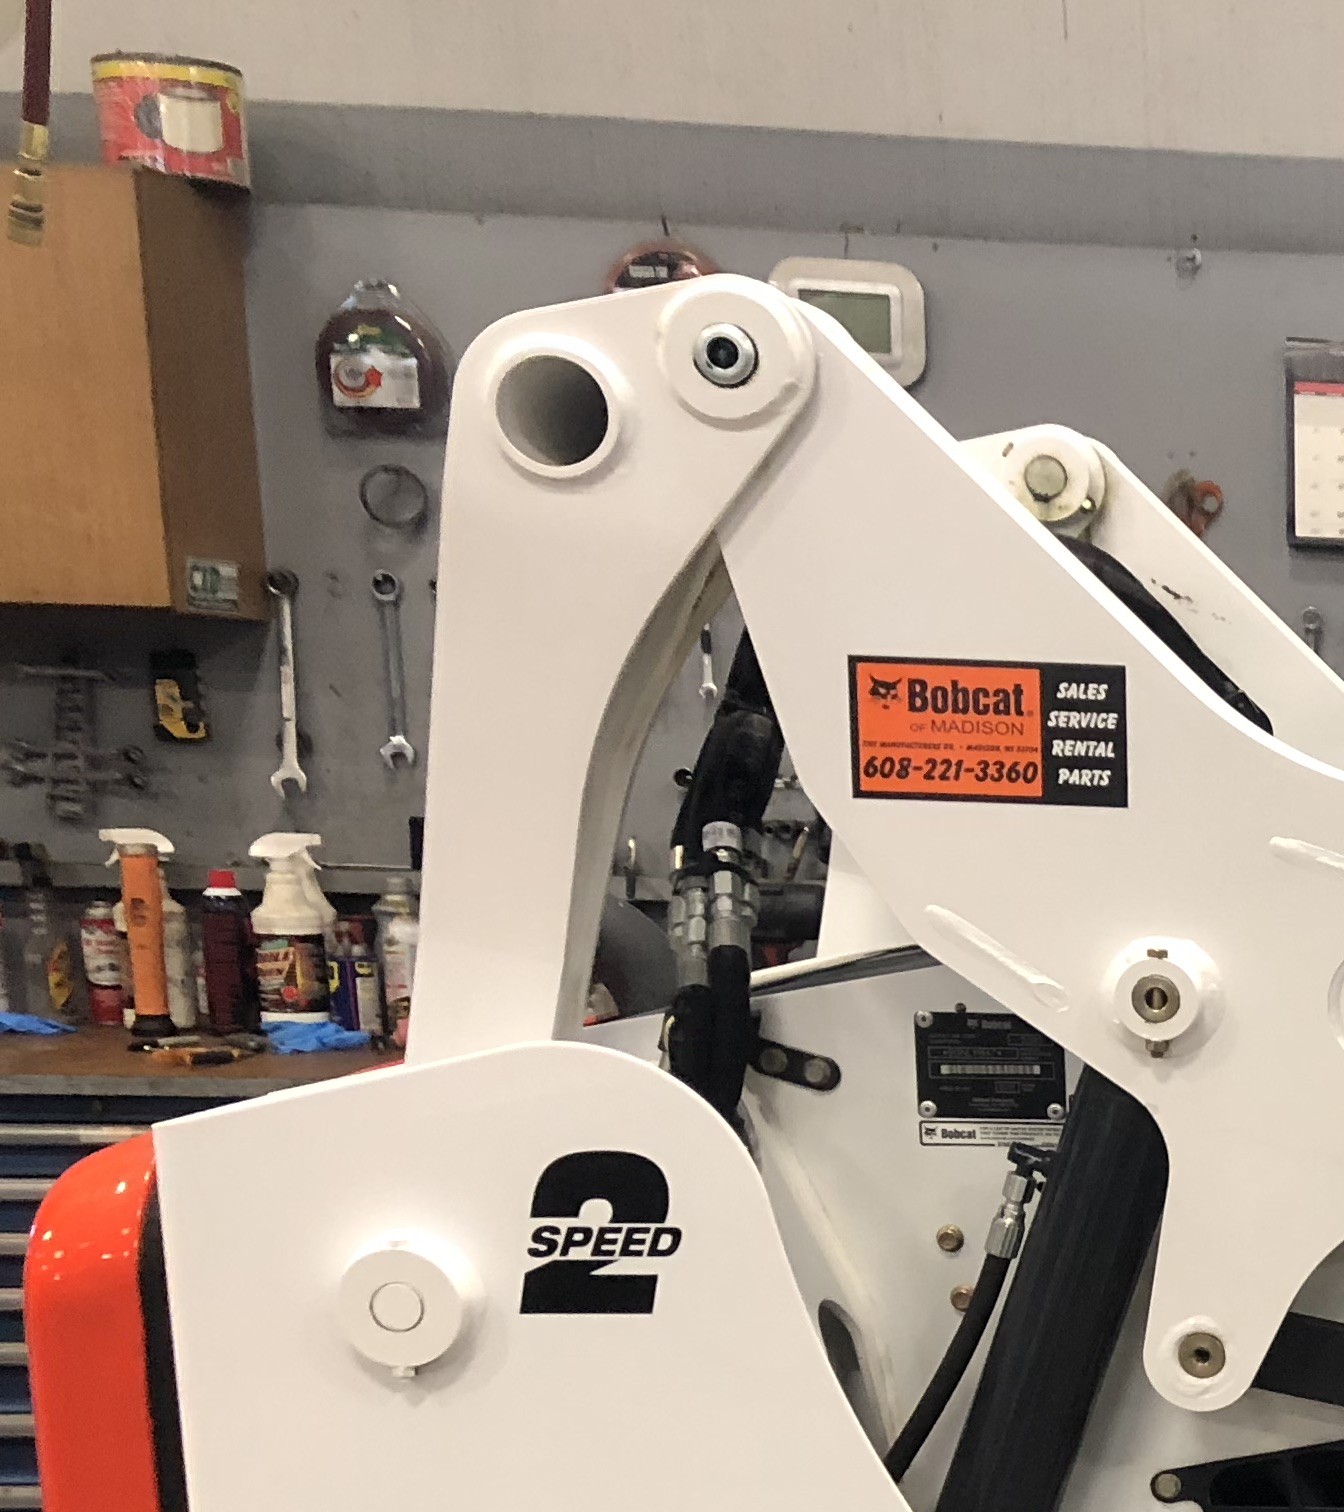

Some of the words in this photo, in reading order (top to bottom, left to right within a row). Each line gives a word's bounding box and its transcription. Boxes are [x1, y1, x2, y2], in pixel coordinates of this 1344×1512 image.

[907, 678, 1024, 717] Bobcat
[1056, 682, 1108, 700] SALES
[910, 723, 925, 732] OF
[930, 719, 1024, 737] MADISON
[1047, 711, 1118, 729] SERVICE
[1052, 739, 1115, 758] RENTAL
[863, 756, 1039, 784] 608-221-3360
[1058, 768, 1111, 786] PARTS
[941, 1128, 976, 1140] Bobcat
[519, 1150, 671, 1315] 2
[527, 1225, 682, 1258] SPEED
